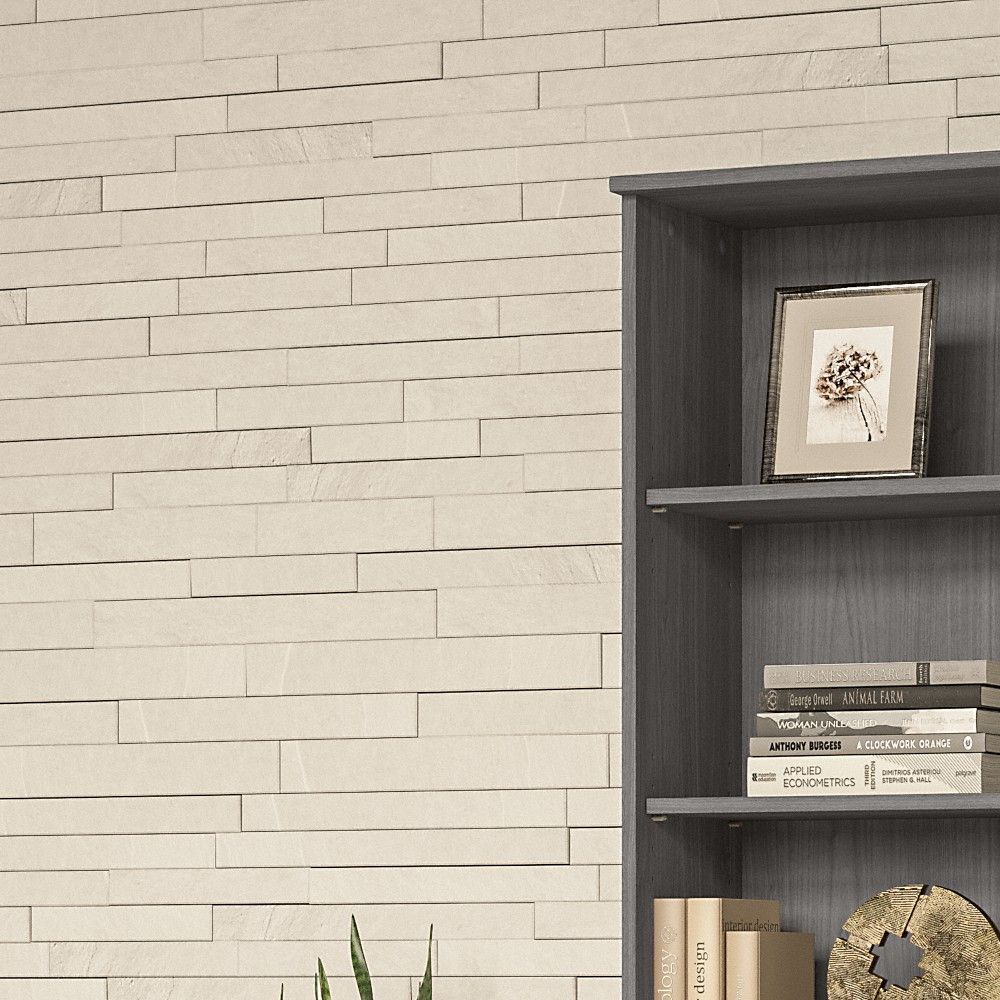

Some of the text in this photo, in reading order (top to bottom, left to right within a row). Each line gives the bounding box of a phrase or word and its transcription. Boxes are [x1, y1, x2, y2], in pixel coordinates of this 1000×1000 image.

[795, 669, 849, 683] BUSINESS
[789, 693, 833, 709] George Orwell
[880, 690, 904, 704] FARM
[777, 721, 818, 729] WOMAN
[769, 741, 842, 752] ANTHONY BURGESS
[856, 738, 951, 750] A CLOCKWORK ORANGE
[783, 766, 822, 776] APPLIED
[783, 777, 856, 788] ECONOMETRICS
[882, 776, 908, 784] STEPHEN
[694, 941, 709, 994] design
